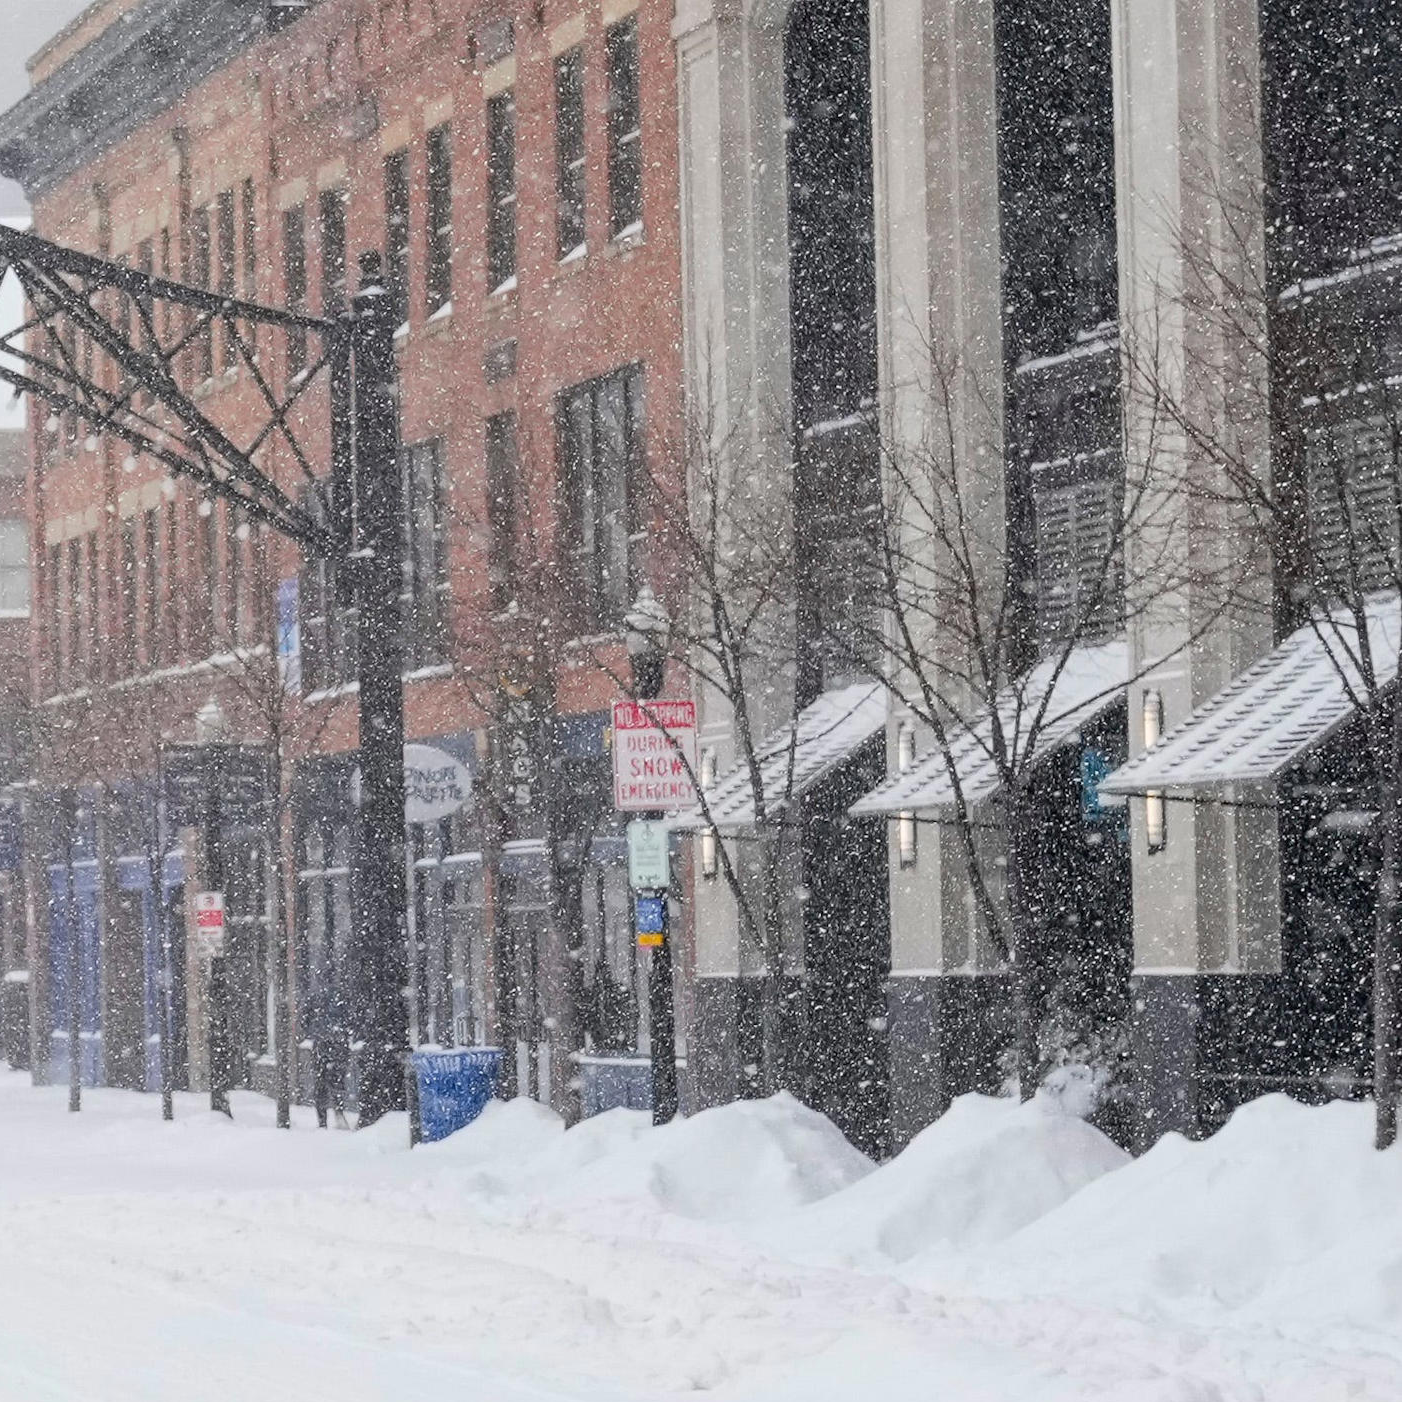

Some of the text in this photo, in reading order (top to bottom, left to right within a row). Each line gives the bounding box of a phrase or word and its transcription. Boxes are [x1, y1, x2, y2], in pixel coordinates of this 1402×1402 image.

[616, 706, 633, 726] NO
[627, 734, 684, 753] DURING
[630, 756, 682, 777] SNOW
[620, 781, 693, 801] EMERGENCY
